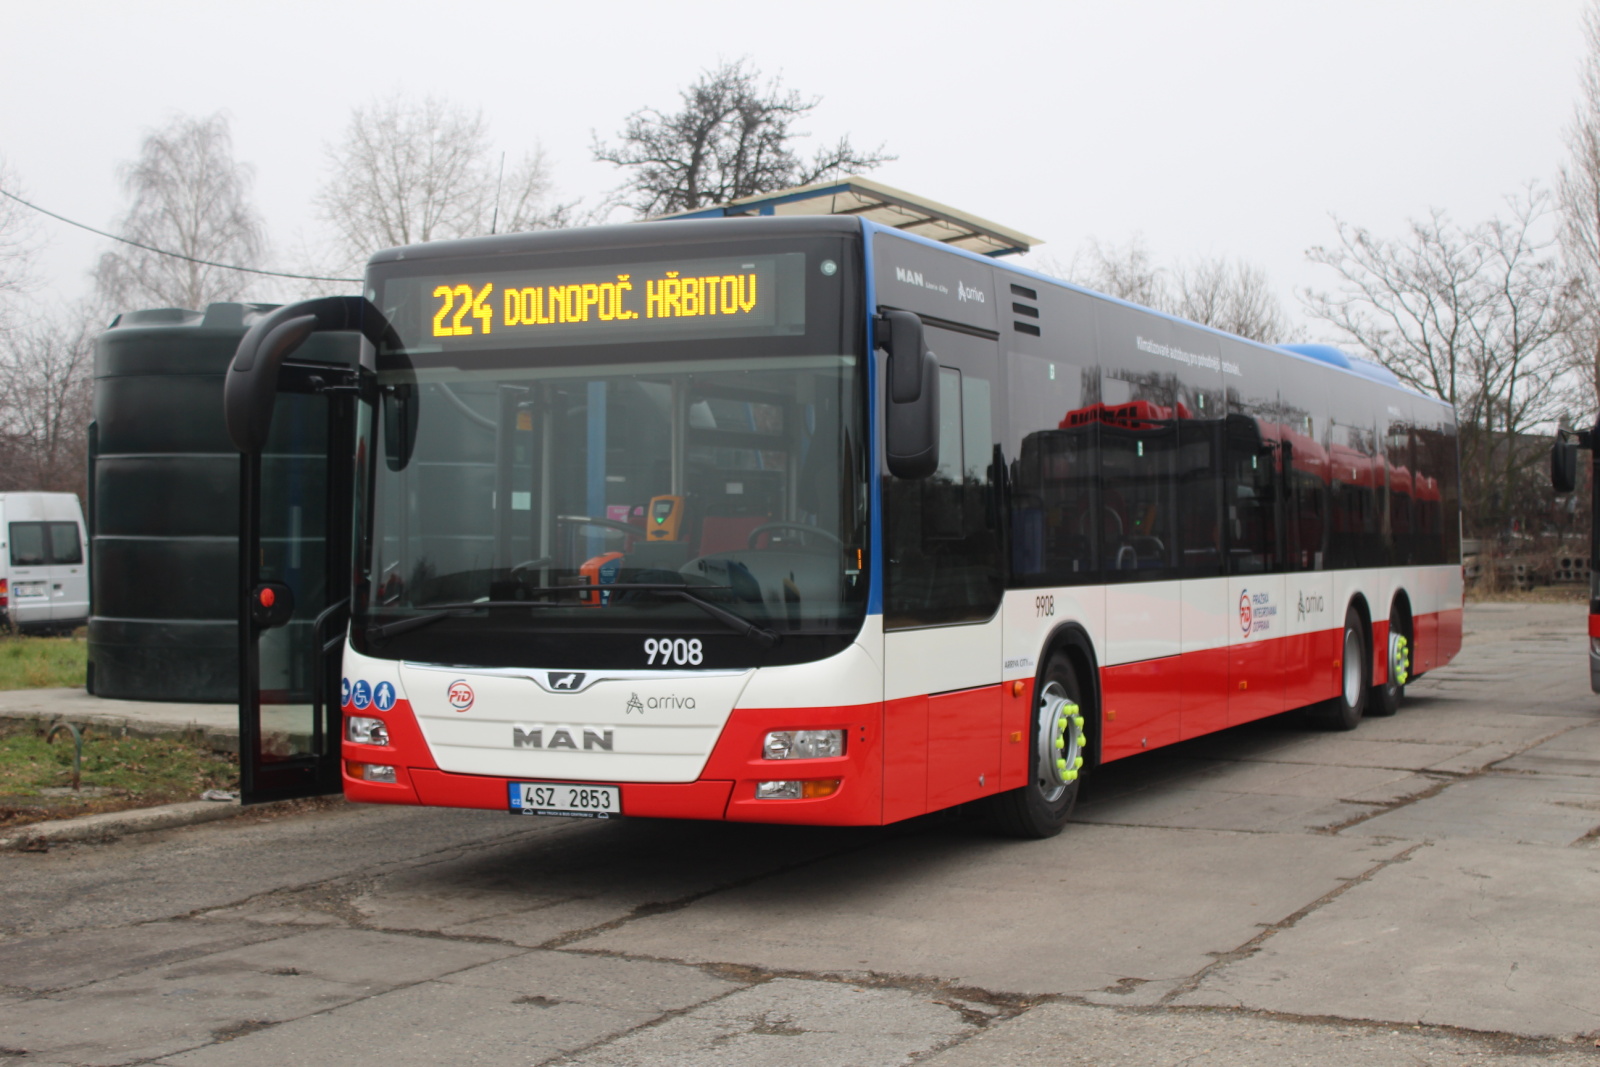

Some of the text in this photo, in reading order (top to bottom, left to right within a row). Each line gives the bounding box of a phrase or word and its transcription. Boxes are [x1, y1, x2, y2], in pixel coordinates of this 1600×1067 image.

[895, 266, 924, 287] MAN
[433, 271, 757, 337] 224 DOLNOPOČ. HŘBITOV
[1035, 595, 1055, 618] 9908
[644, 638, 704, 666] 9908
[647, 693, 696, 710] arriva
[513, 726, 614, 751] MAN
[525, 787, 611, 809] 4SZ 2853
